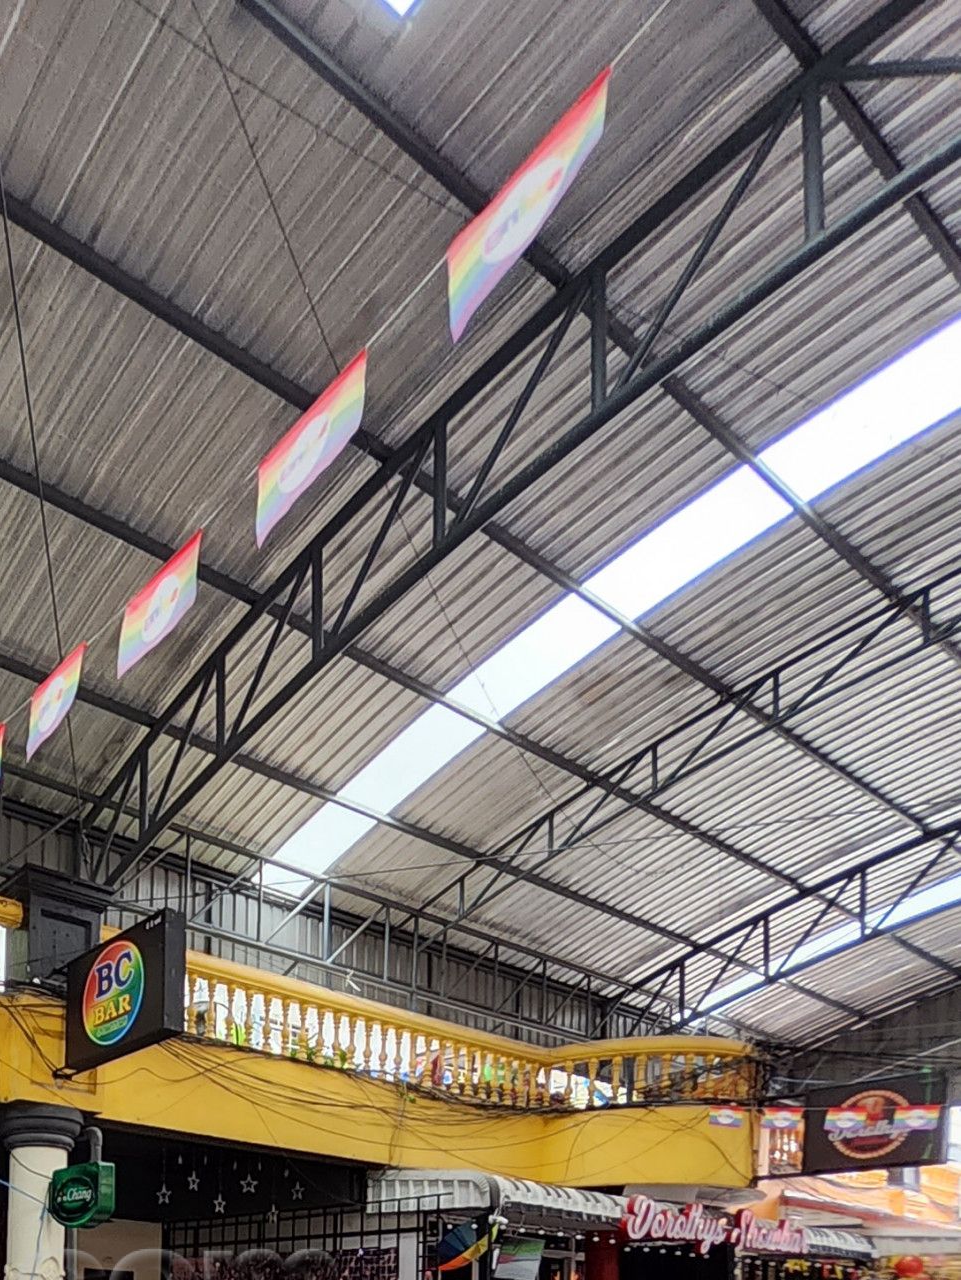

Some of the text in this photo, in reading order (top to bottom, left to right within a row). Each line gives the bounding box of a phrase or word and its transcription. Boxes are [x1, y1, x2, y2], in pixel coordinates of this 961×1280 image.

[94, 950, 134, 1001] BC
[92, 995, 132, 1026] BAR
[66, 1187, 92, 1202] Chang
